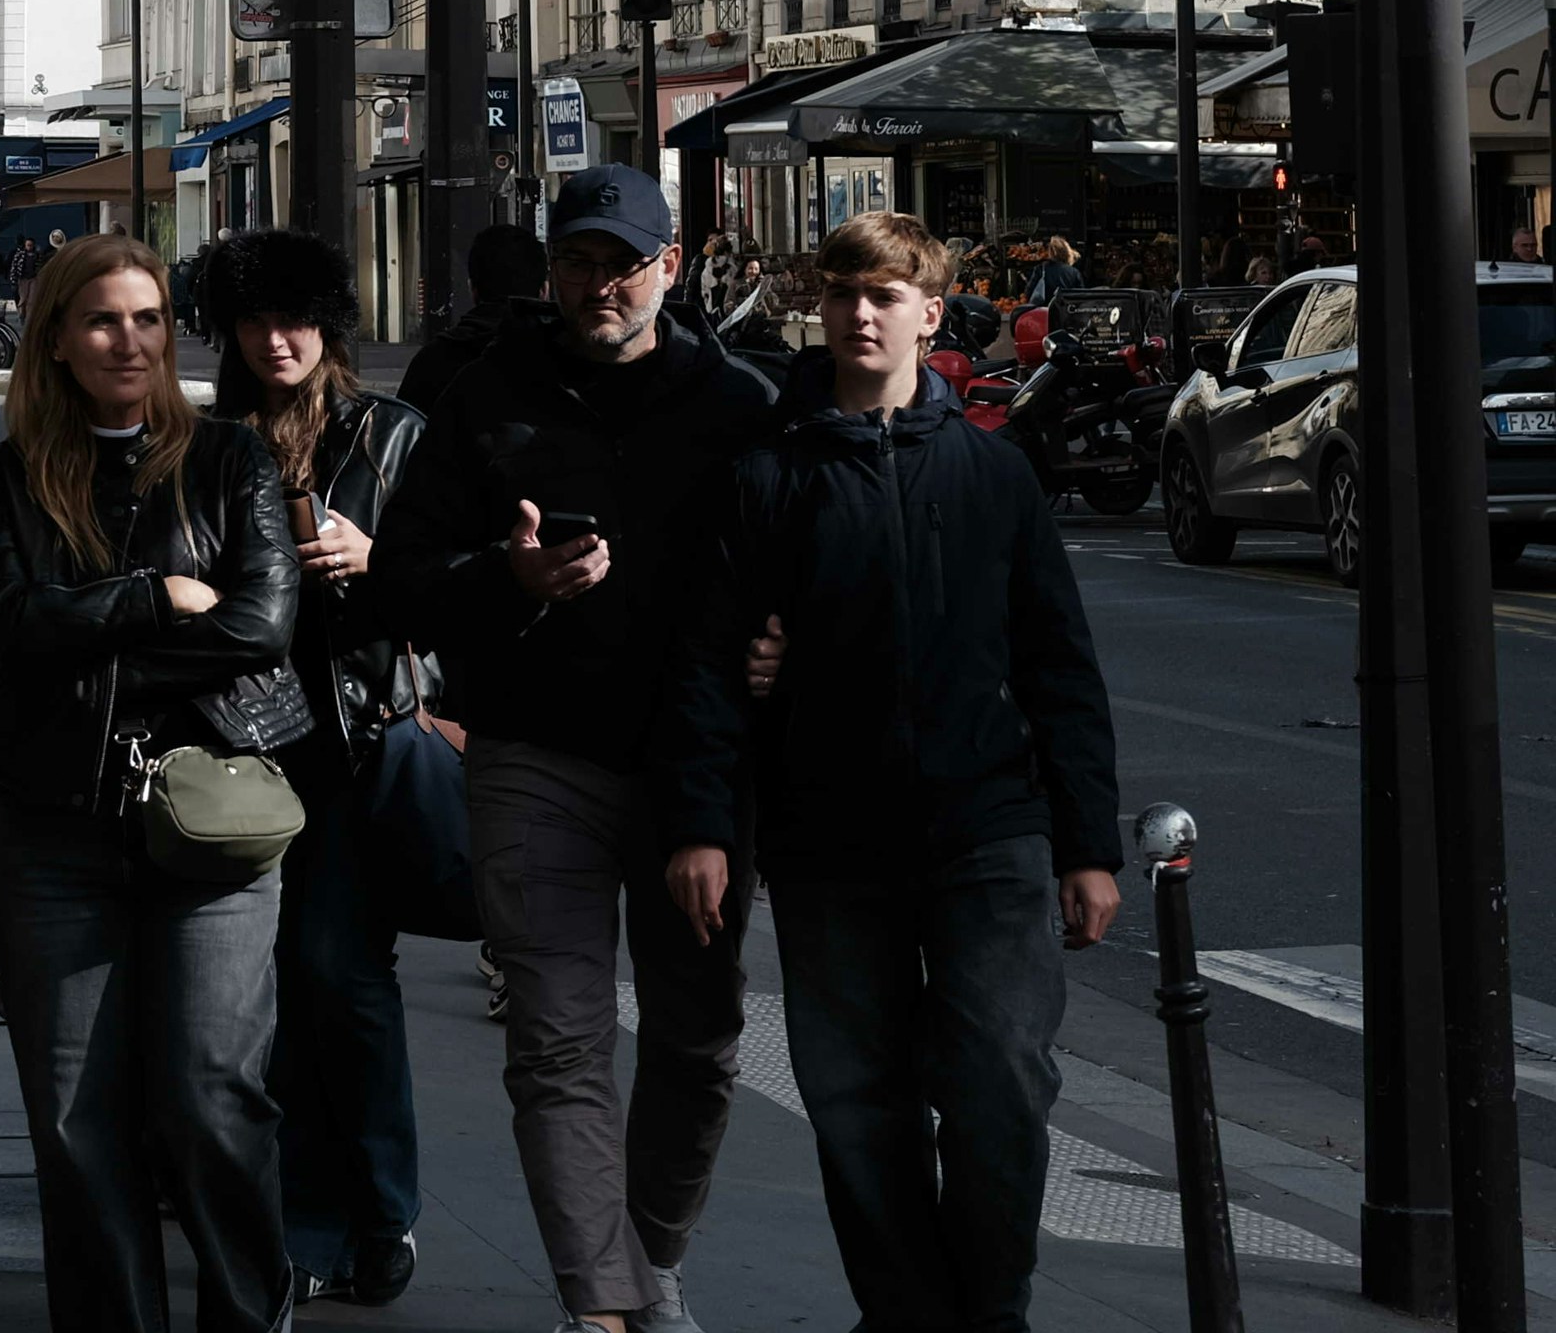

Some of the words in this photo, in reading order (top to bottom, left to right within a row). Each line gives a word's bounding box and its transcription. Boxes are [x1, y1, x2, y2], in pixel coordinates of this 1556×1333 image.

[1490, 49, 1551, 121] CA
[488, 107, 506, 126] R
[548, 99, 580, 124] CHANGE
[874, 117, 923, 135] Terroir
